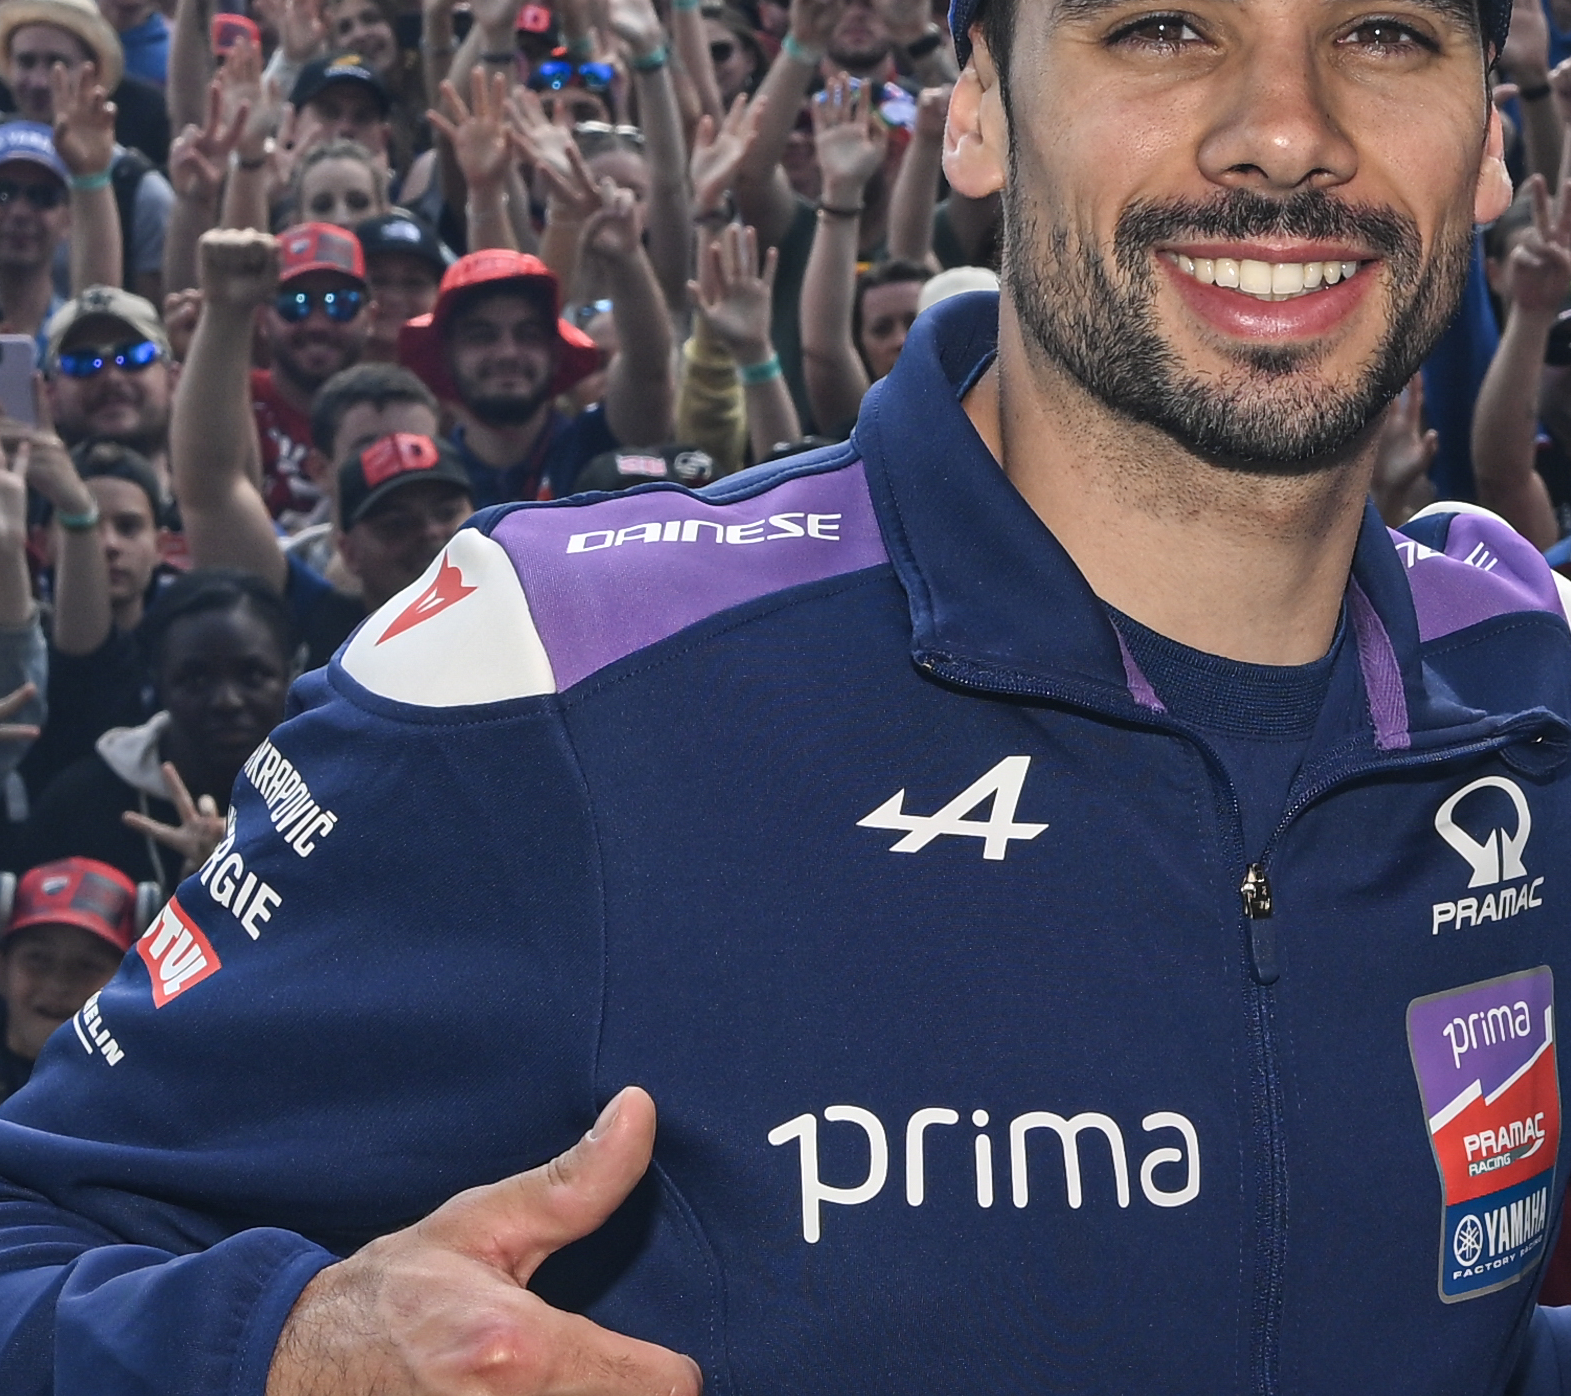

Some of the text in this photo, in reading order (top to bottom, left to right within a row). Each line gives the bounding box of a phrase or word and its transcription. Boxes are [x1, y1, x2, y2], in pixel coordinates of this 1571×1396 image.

[565, 506, 842, 555] DAINESE
[1432, 876, 1544, 935] PRAMAC
[1443, 999, 1531, 1070] prima
[1463, 1112, 1546, 1161] PRAMAC
[767, 1105, 1200, 1244] prima
[1469, 1152, 1512, 1177] RACING
[1484, 1186, 1548, 1257] YAMAHA
[1453, 1254, 1516, 1280] FACTORY
